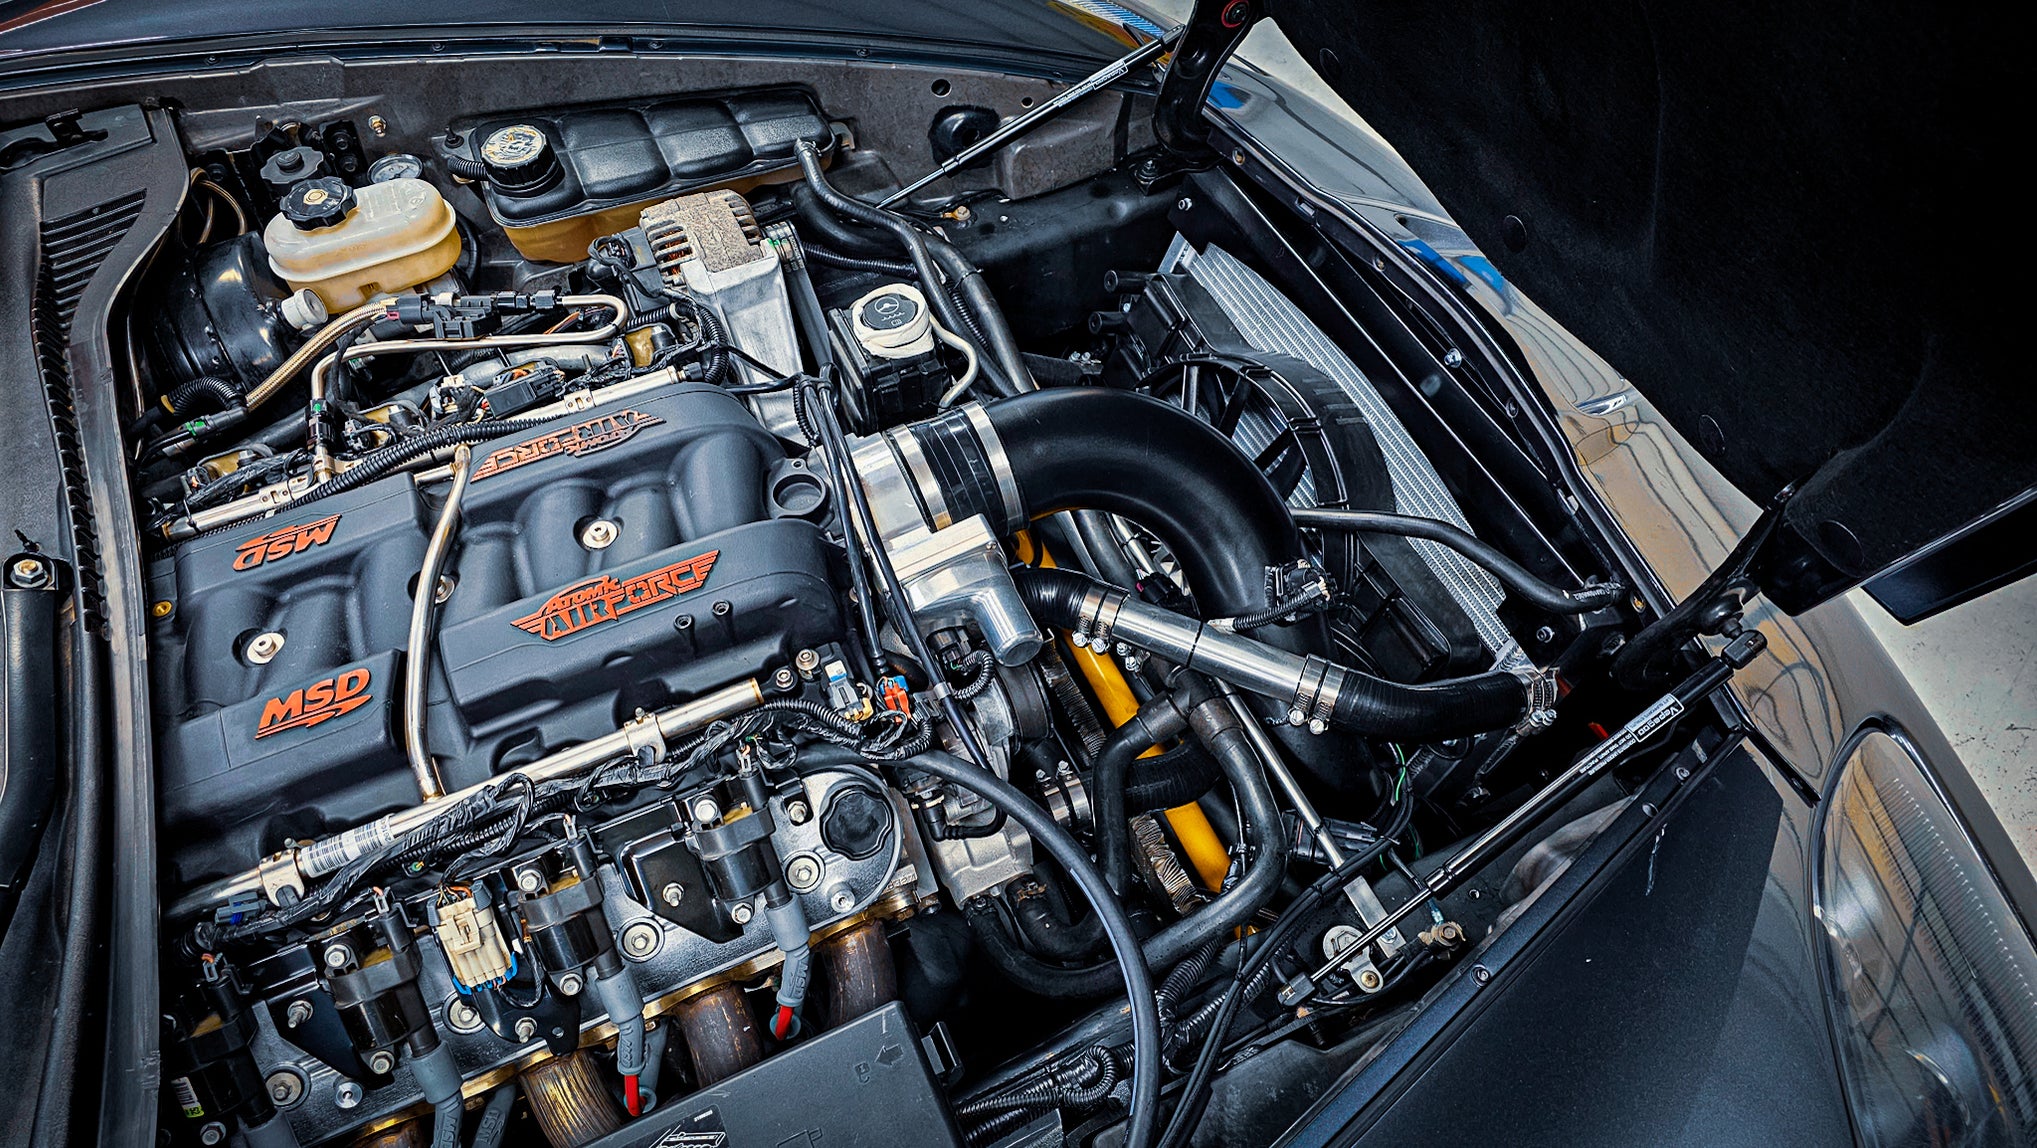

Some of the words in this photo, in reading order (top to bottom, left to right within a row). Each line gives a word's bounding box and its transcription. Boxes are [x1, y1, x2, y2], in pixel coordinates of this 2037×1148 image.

[233, 519, 337, 571] MSD
[541, 563, 714, 642] AIRFORCE
[257, 668, 371, 731] MSD
[1636, 705, 1679, 736] Vepagoo
